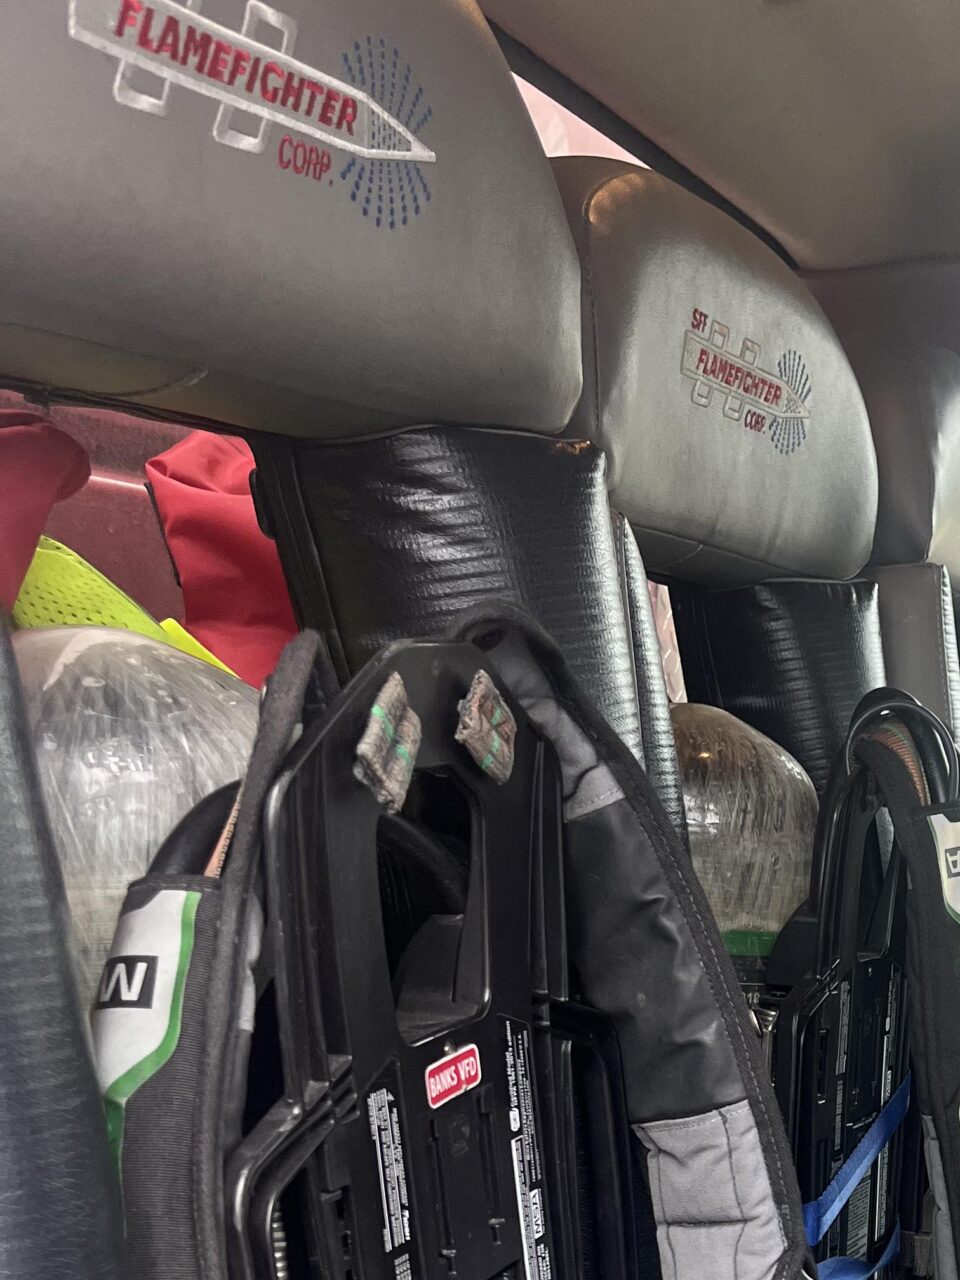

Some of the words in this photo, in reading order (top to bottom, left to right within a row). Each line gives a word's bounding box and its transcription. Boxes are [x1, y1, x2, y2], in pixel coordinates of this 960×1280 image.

[115, 0, 358, 135] FLAMEFIGHTER
[277, 134, 333, 187] CORP.
[696, 348, 783, 408] FLAMEFIGHTER
[429, 1065, 458, 1098] BANKS
[457, 1056, 477, 1081] VFD
